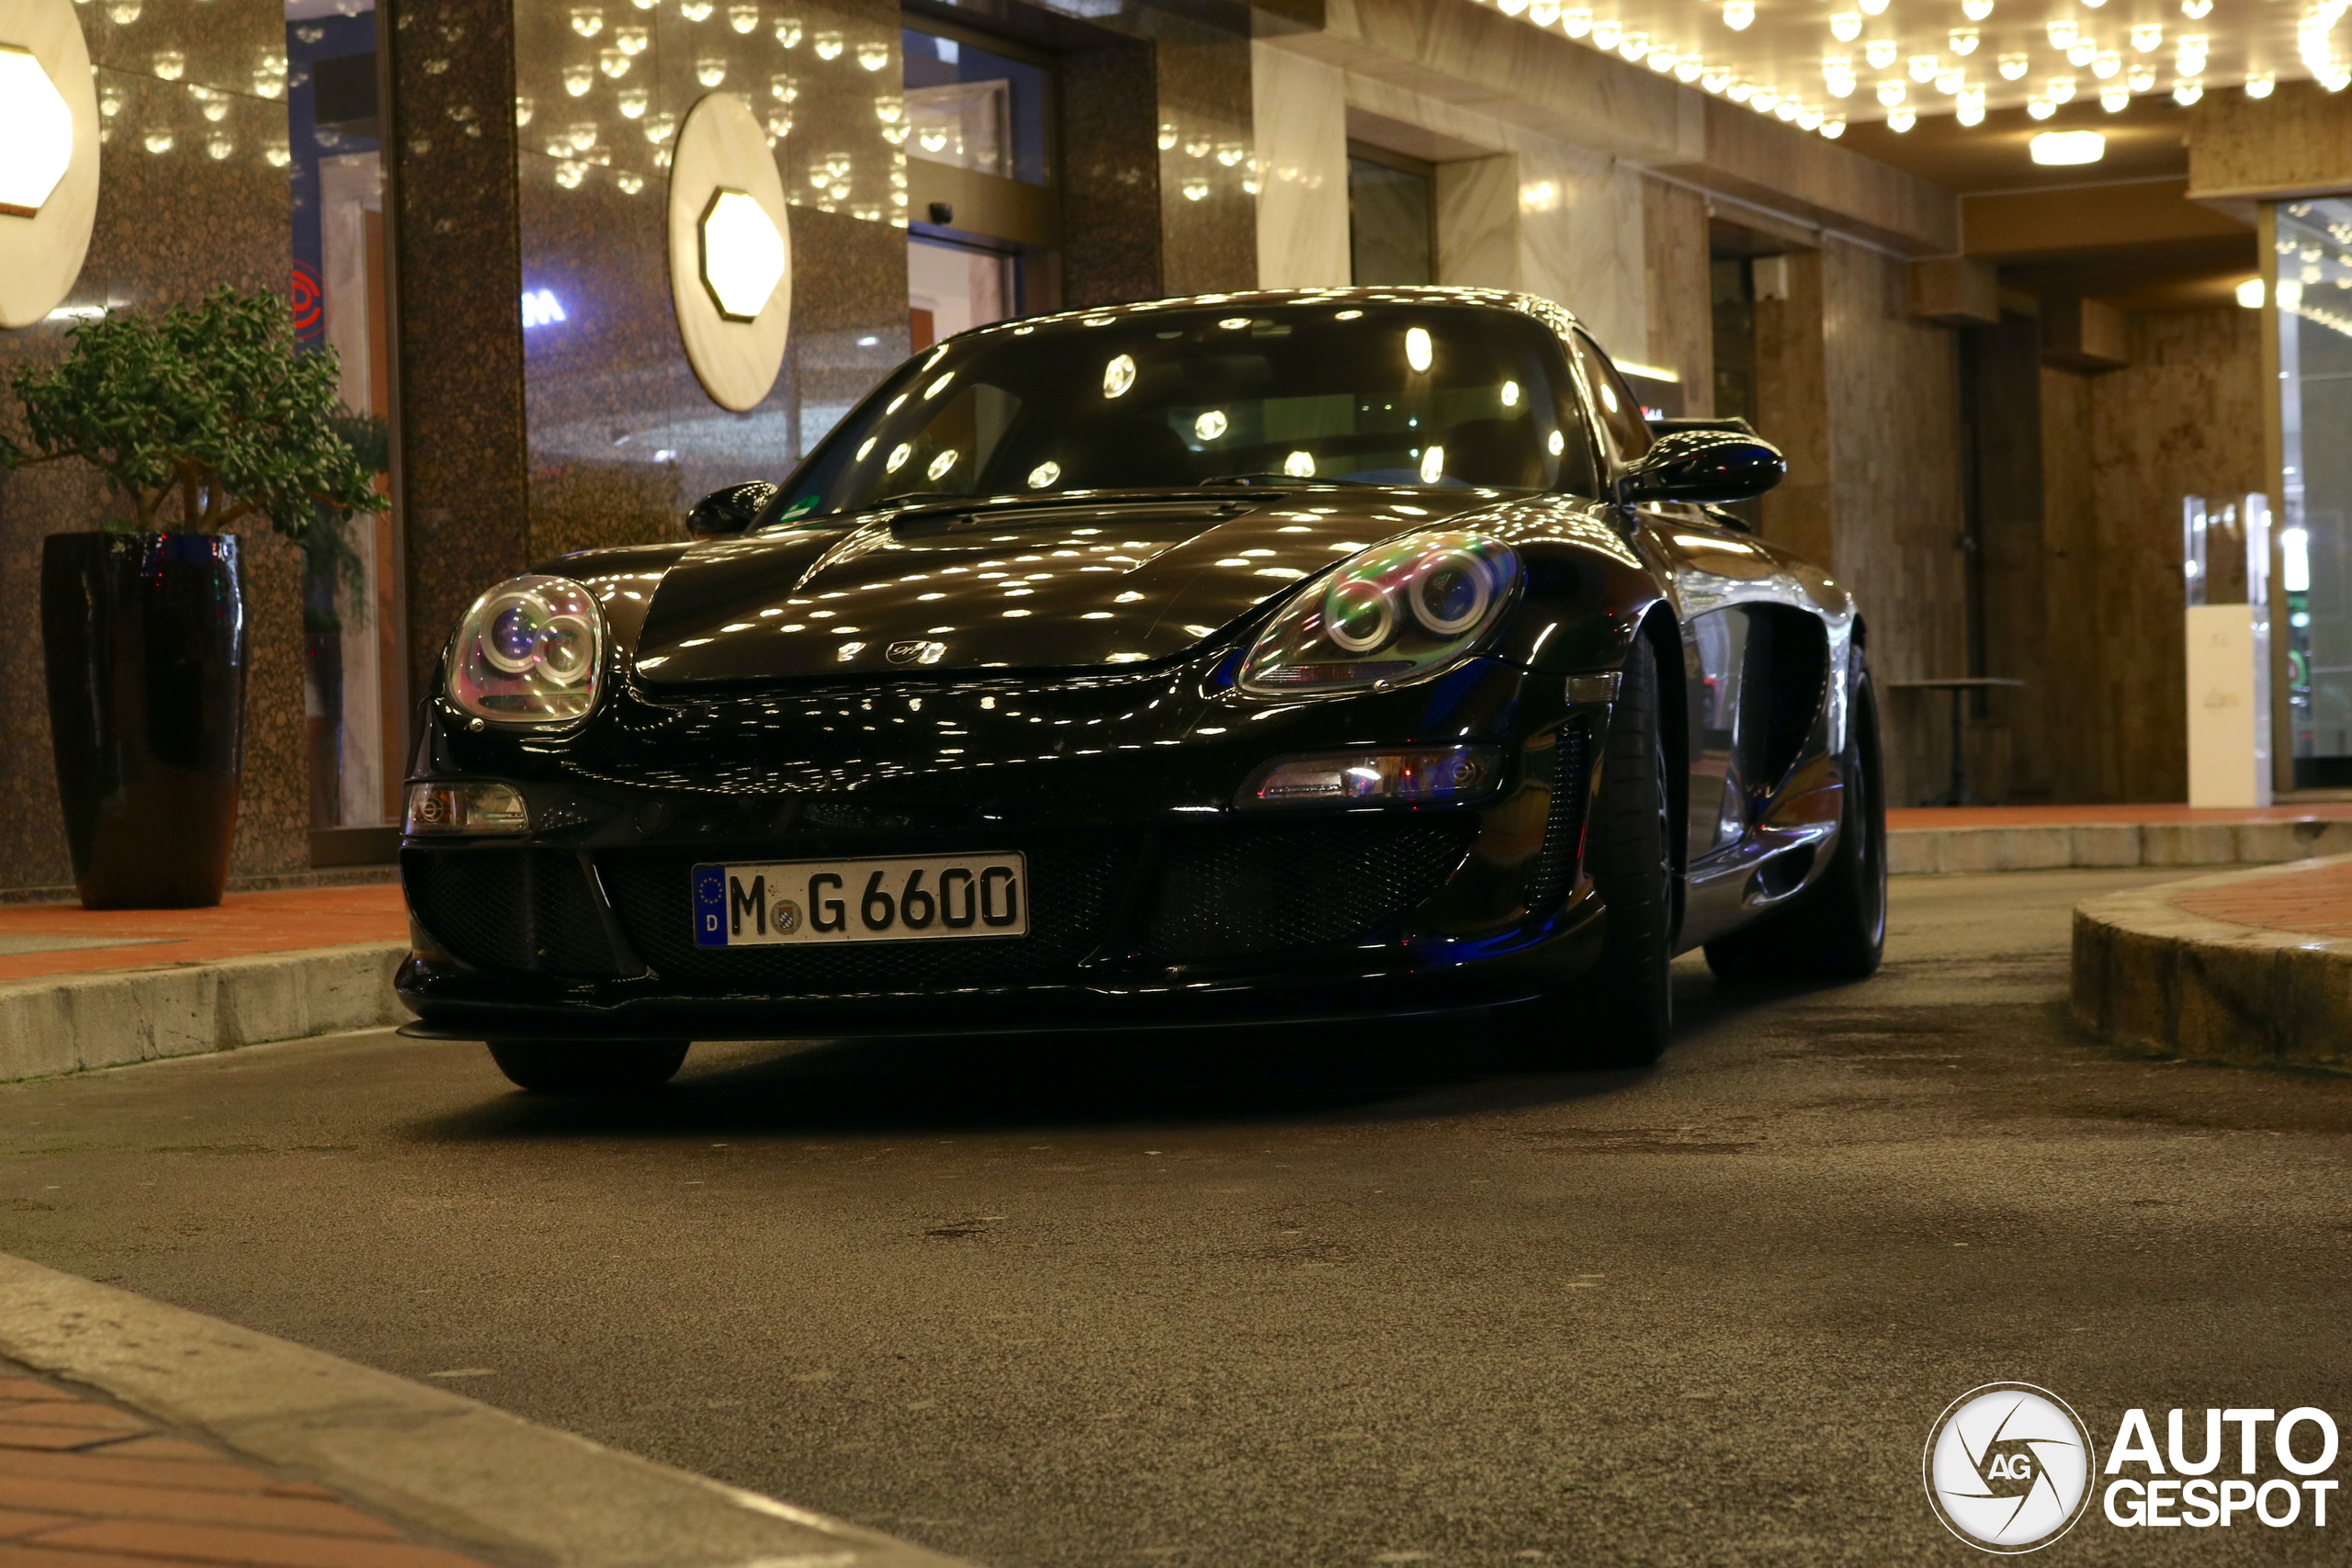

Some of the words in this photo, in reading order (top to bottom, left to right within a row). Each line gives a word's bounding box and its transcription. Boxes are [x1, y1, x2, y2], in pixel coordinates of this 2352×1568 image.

[730, 874, 765, 935] M
[808, 873, 846, 932] G
[861, 866, 1017, 931] 6600
[707, 915, 718, 931] D
